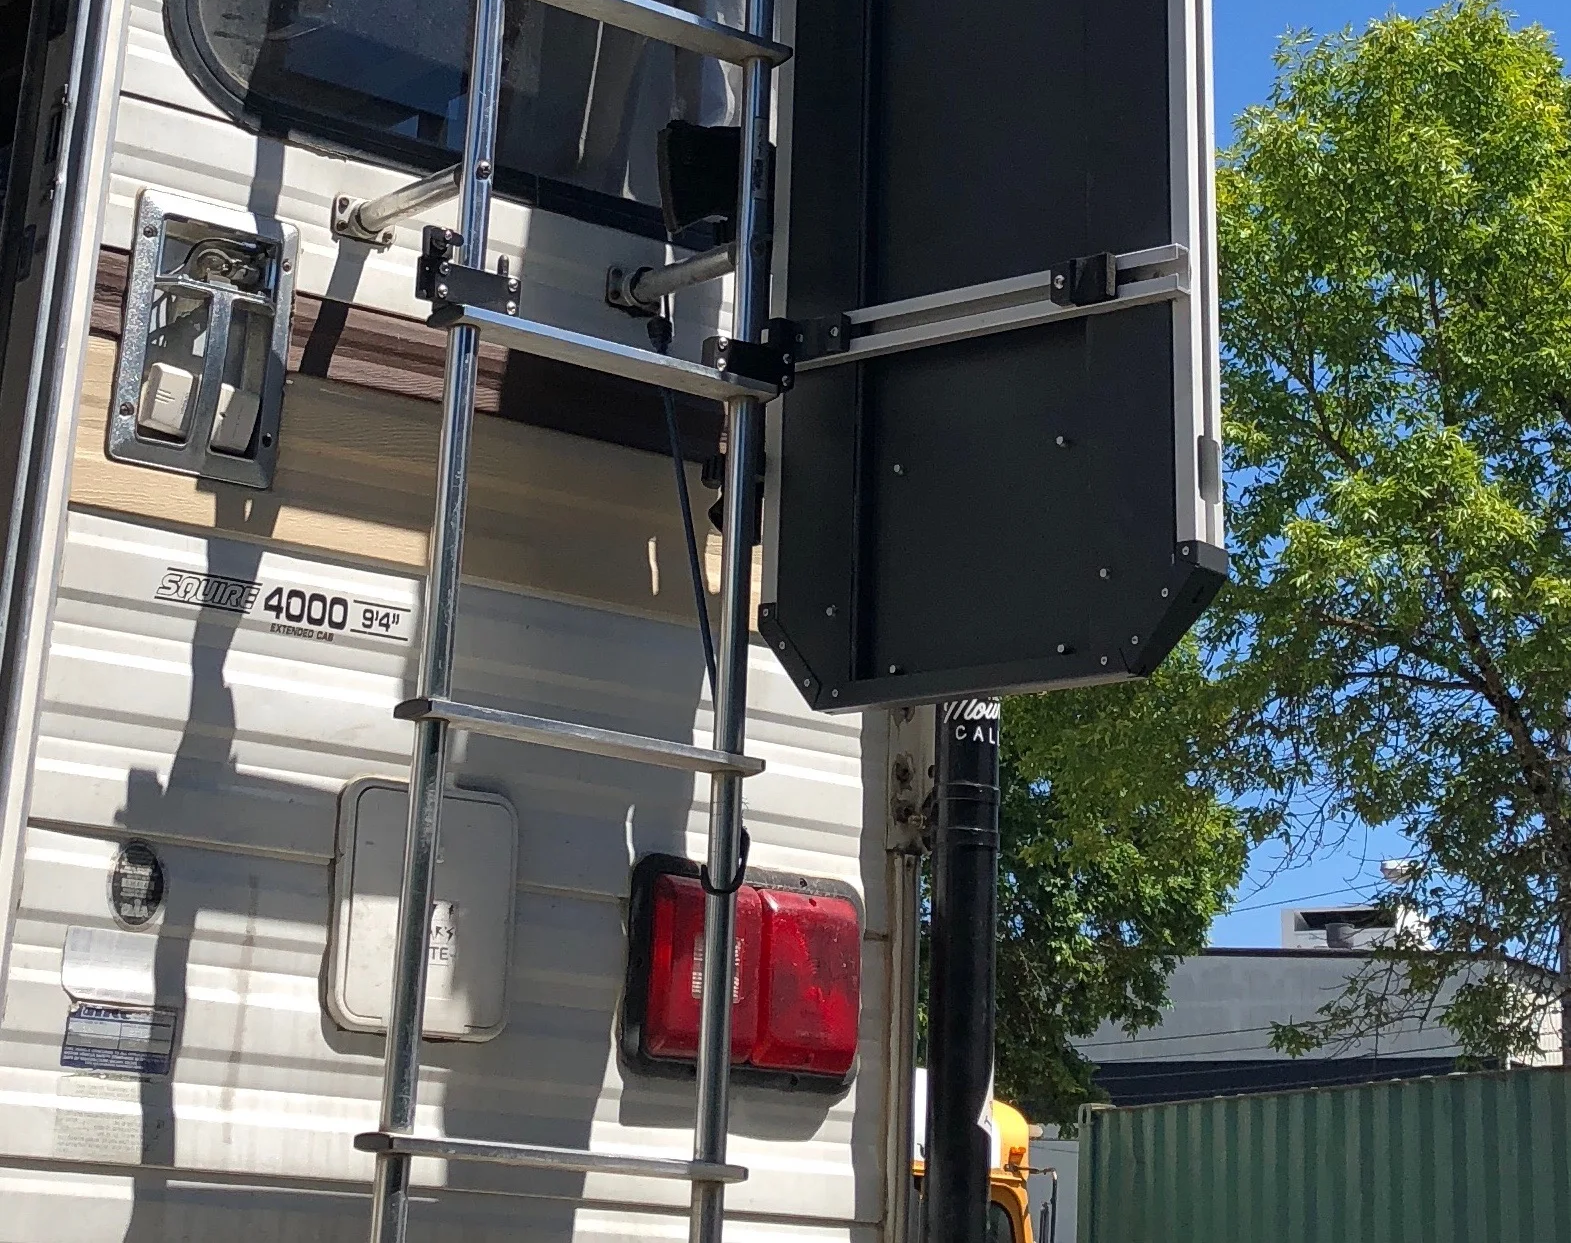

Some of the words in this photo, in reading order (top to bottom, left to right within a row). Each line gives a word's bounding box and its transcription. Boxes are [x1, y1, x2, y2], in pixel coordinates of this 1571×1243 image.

[157, 572, 261, 610] SQUIRE
[263, 586, 348, 630] 4000
[269, 622, 314, 639] EXTENDED
[316, 629, 334, 642] CAB
